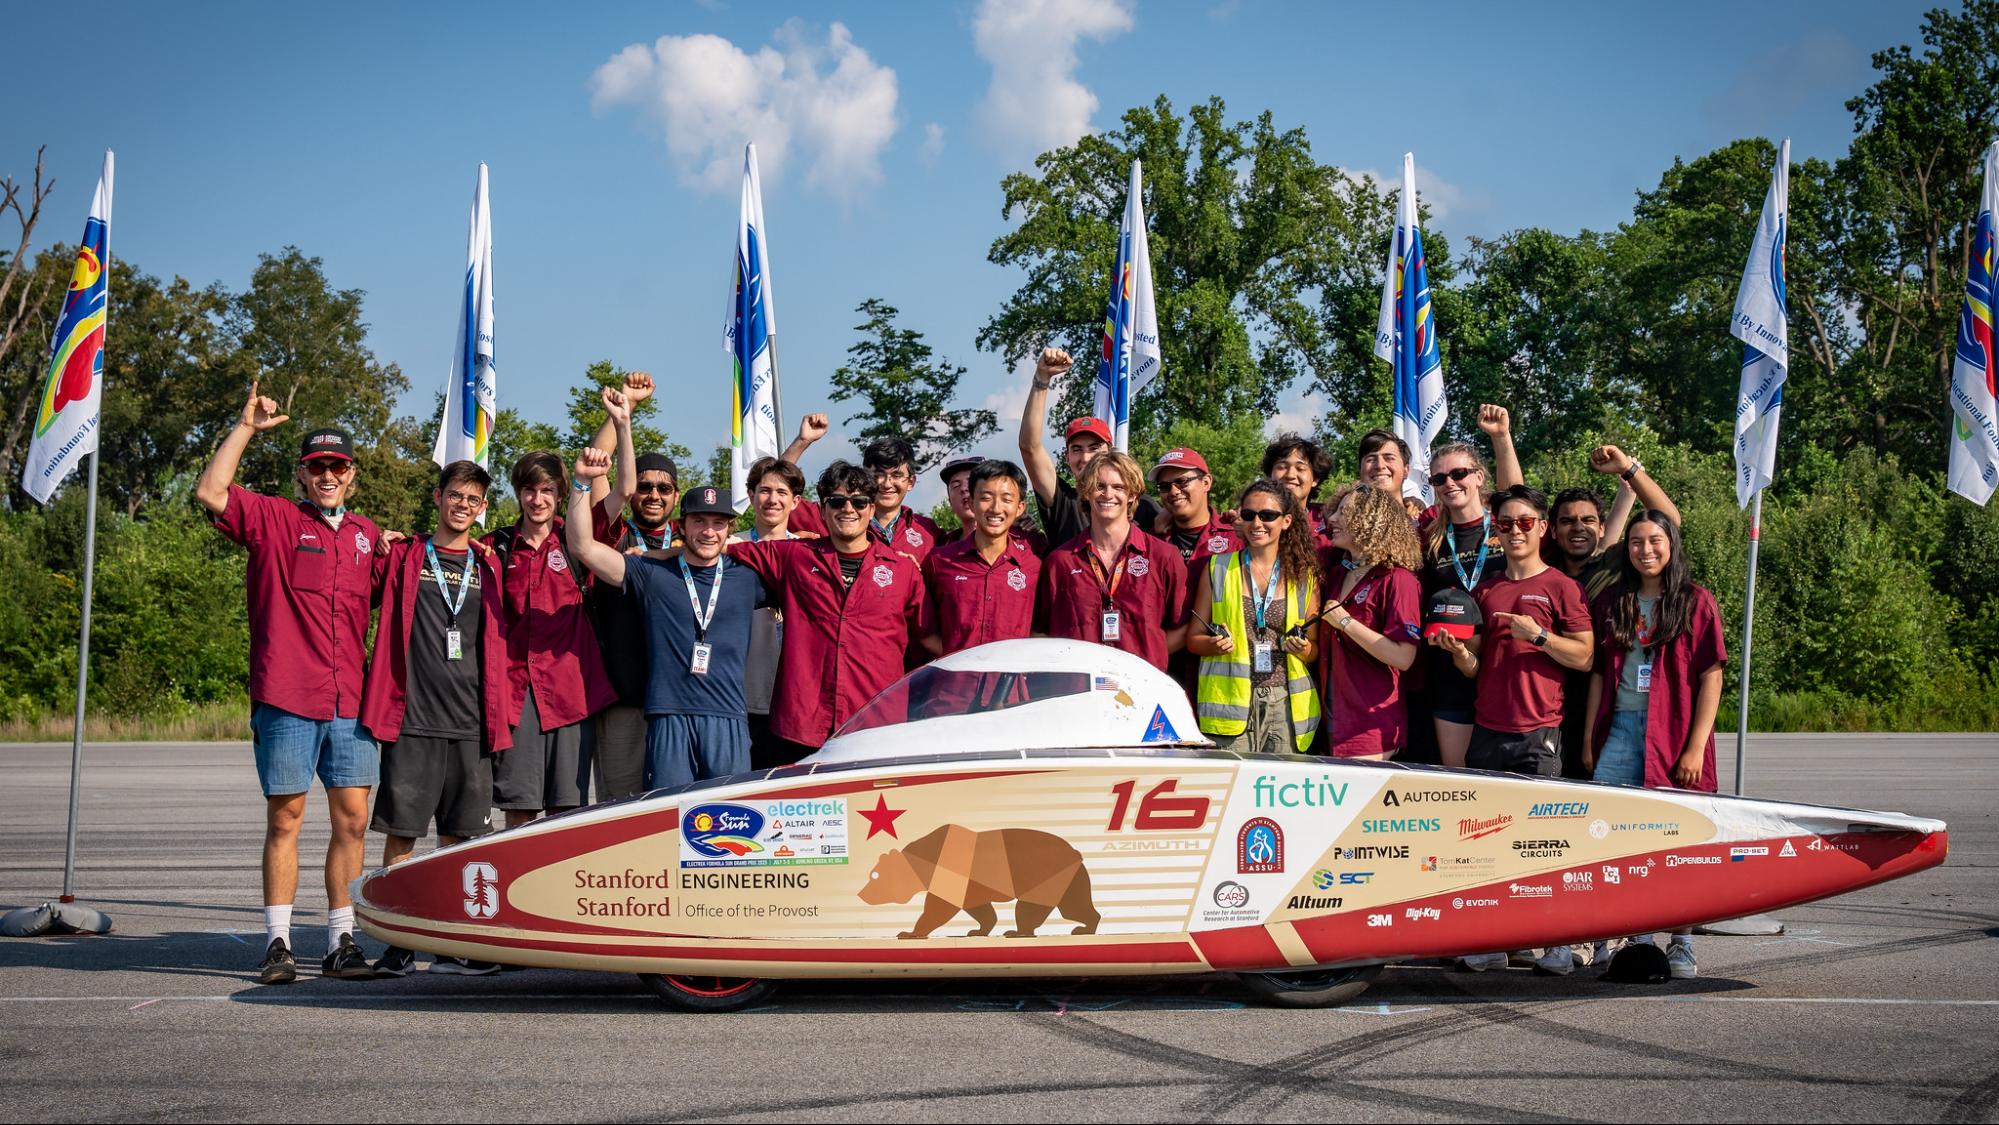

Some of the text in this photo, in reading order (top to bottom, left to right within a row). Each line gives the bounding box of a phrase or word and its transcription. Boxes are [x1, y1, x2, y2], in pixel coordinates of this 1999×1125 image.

[1739, 315, 1755, 330] By
[1253, 774, 1349, 808] fictiv
[1403, 790, 1477, 803] AUTODESK
[768, 800, 844, 817] electrek
[1107, 779, 1210, 831] 16
[1528, 802, 1589, 816] AIRTECH
[719, 812, 749, 831] Sun
[784, 820, 815, 828] ALTAIR
[1362, 818, 1441, 833] SIEMENS
[1456, 813, 1513, 836] Milwaukee
[1611, 823, 1680, 831] UNIFORMITY
[1102, 840, 1200, 851] AZIMUTH
[1520, 850, 1563, 858] CIRCUITS
[1677, 856, 1722, 865] OPENBUILDS
[1573, 871, 1592, 883] IAR
[1629, 865, 1648, 877] nrg
[575, 869, 809, 889] Stanford ENGINEERING
[1340, 872, 1375, 885] SCT
[1520, 885, 1552, 893] Fibrotek
[1563, 883, 1593, 891] SYSTEMS
[1217, 892, 1245, 901] CARS
[1287, 895, 1343, 909] Altium
[577, 897, 819, 918] Stanford Office of the Provost
[1367, 913, 1393, 927] 3M
